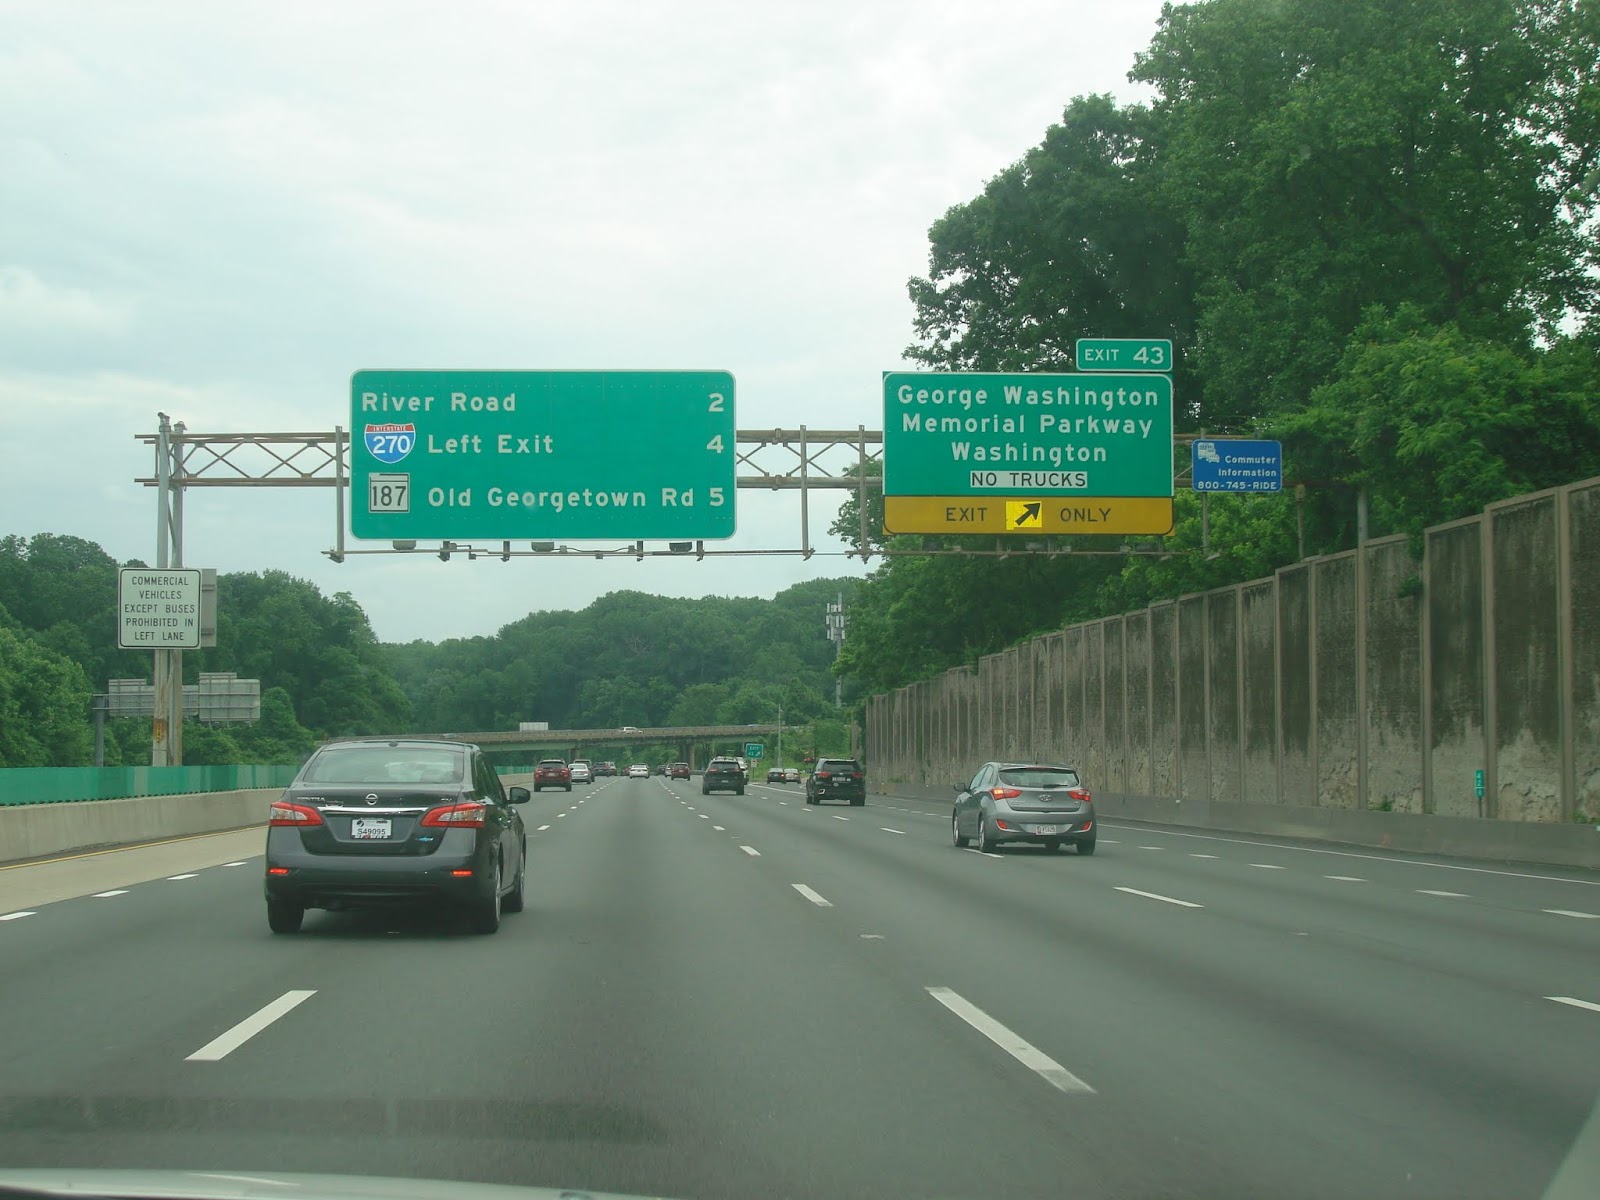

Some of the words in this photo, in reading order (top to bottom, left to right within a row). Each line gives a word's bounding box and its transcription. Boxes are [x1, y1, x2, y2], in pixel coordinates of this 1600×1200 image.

[1085, 349, 1120, 361] EXIT
[1133, 346, 1164, 364] 43
[362, 392, 434, 412] River
[451, 392, 516, 412] Road
[708, 393, 724, 412] 2
[898, 384, 988, 410] George
[1004, 386, 1158, 412] Washington
[902, 413, 1024, 433] Memorial
[1040, 414, 1152, 438] Parkway
[372, 435, 410, 454] 270
[428, 434, 482, 454] Left
[498, 434, 554, 454] Exit
[706, 435, 724, 454] 4
[952, 442, 1106, 468] Washington
[1224, 455, 1276, 464] Commuter
[972, 472, 997, 486] NO
[1010, 472, 1086, 486] TRUCKS
[1218, 468, 1277, 476] Information
[1198, 481, 1277, 490] 800-745-RIDE
[372, 486, 406, 506] 187
[428, 487, 471, 507] Old
[487, 488, 646, 513] Georgetown
[662, 488, 694, 507] Rd
[708, 488, 724, 507] 5
[946, 508, 988, 522] EXIT
[1060, 508, 1112, 522] ONLY
[131, 576, 190, 586] COMMERCIAL
[140, 590, 182, 600] VEHICLES
[124, 604, 158, 613] EXCEPT
[166, 604, 195, 614] BUSES
[126, 618, 178, 626] PROHIBITED
[184, 618, 194, 627] IN
[134, 632, 155, 640] LEFT
[162, 632, 184, 640] LANE
